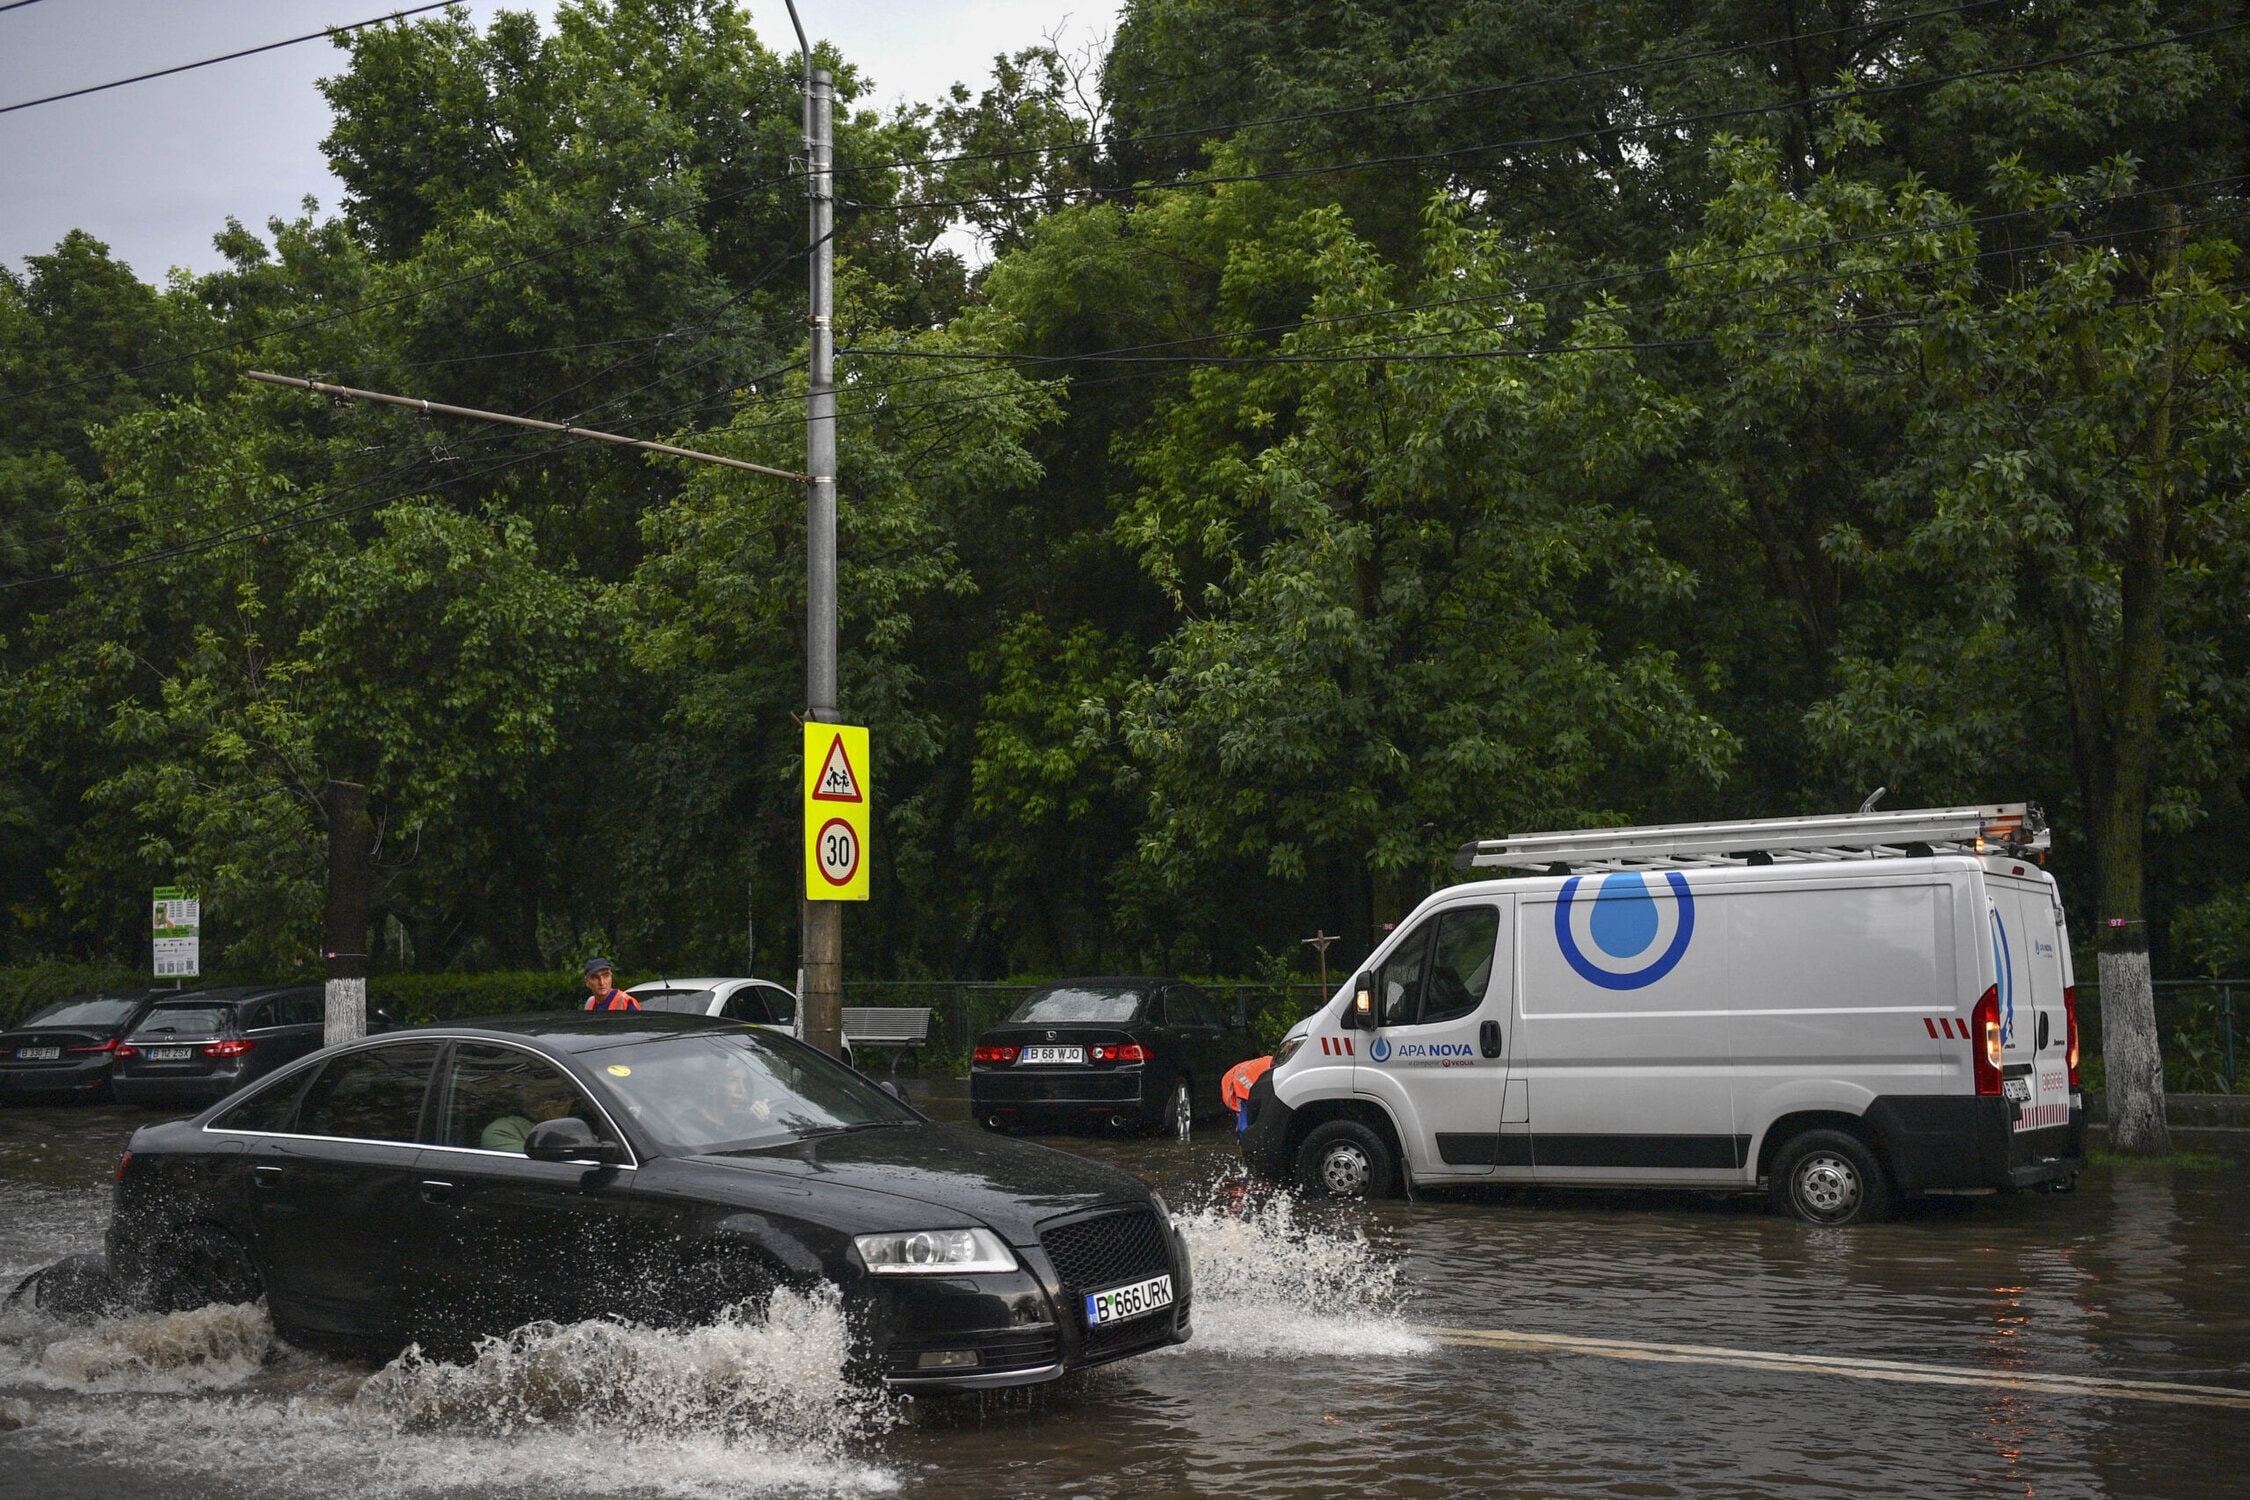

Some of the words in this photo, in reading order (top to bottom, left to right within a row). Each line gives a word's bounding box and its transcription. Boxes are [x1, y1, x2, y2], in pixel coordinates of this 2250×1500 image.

[826, 834, 850, 867] 30
[2110, 918, 2122, 927] 97
[21, 1048, 28, 1057] B
[153, 1049, 159, 1058] B
[172, 1048, 190, 1057] ZSX
[1031, 1048, 1039, 1059] B
[1041, 1048, 1055, 1059] 68
[1056, 1048, 1080, 1059] WJO
[1398, 1044, 1426, 1057] APA
[1429, 1043, 1473, 1056] NOVA
[1096, 1296, 1110, 1322] B
[1115, 1287, 1141, 1316] 666
[1141, 1277, 1171, 1308] URK
